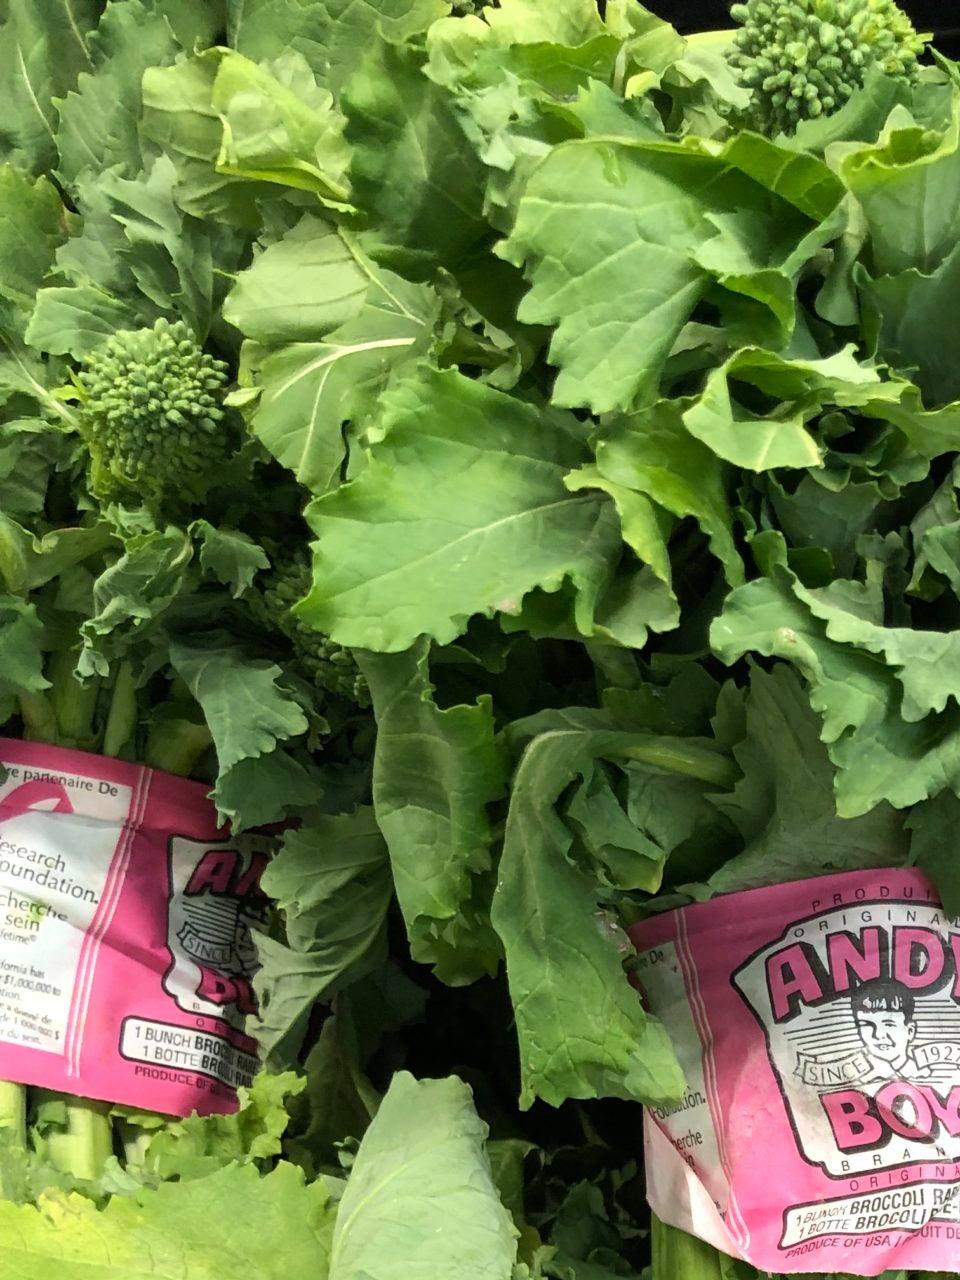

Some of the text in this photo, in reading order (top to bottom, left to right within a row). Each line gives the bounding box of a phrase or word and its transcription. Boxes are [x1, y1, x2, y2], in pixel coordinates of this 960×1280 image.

[98, 781, 118, 797] De
[0, 840, 66, 873] esearch
[0, 860, 99, 904] oundation.
[812, 886, 933, 912] PRODUI
[135, 1025, 140, 1038] 1
[145, 1027, 192, 1048] BUNCH
[143, 1045, 148, 1057] 1
[154, 1047, 198, 1067] BOTTE
[134, 1066, 193, 1086] PRODUCE
[809, 1057, 868, 1082] SINCE
[850, 1188, 924, 1215] BROCCOLI
[800, 1227, 805, 1239] 1
[807, 1219, 853, 1235] BOTTE
[855, 1208, 927, 1230] BROCOLI
[785, 1237, 840, 1259] PRODUCE
[843, 1237, 862, 1248] OF
[865, 1235, 891, 1248] USA
